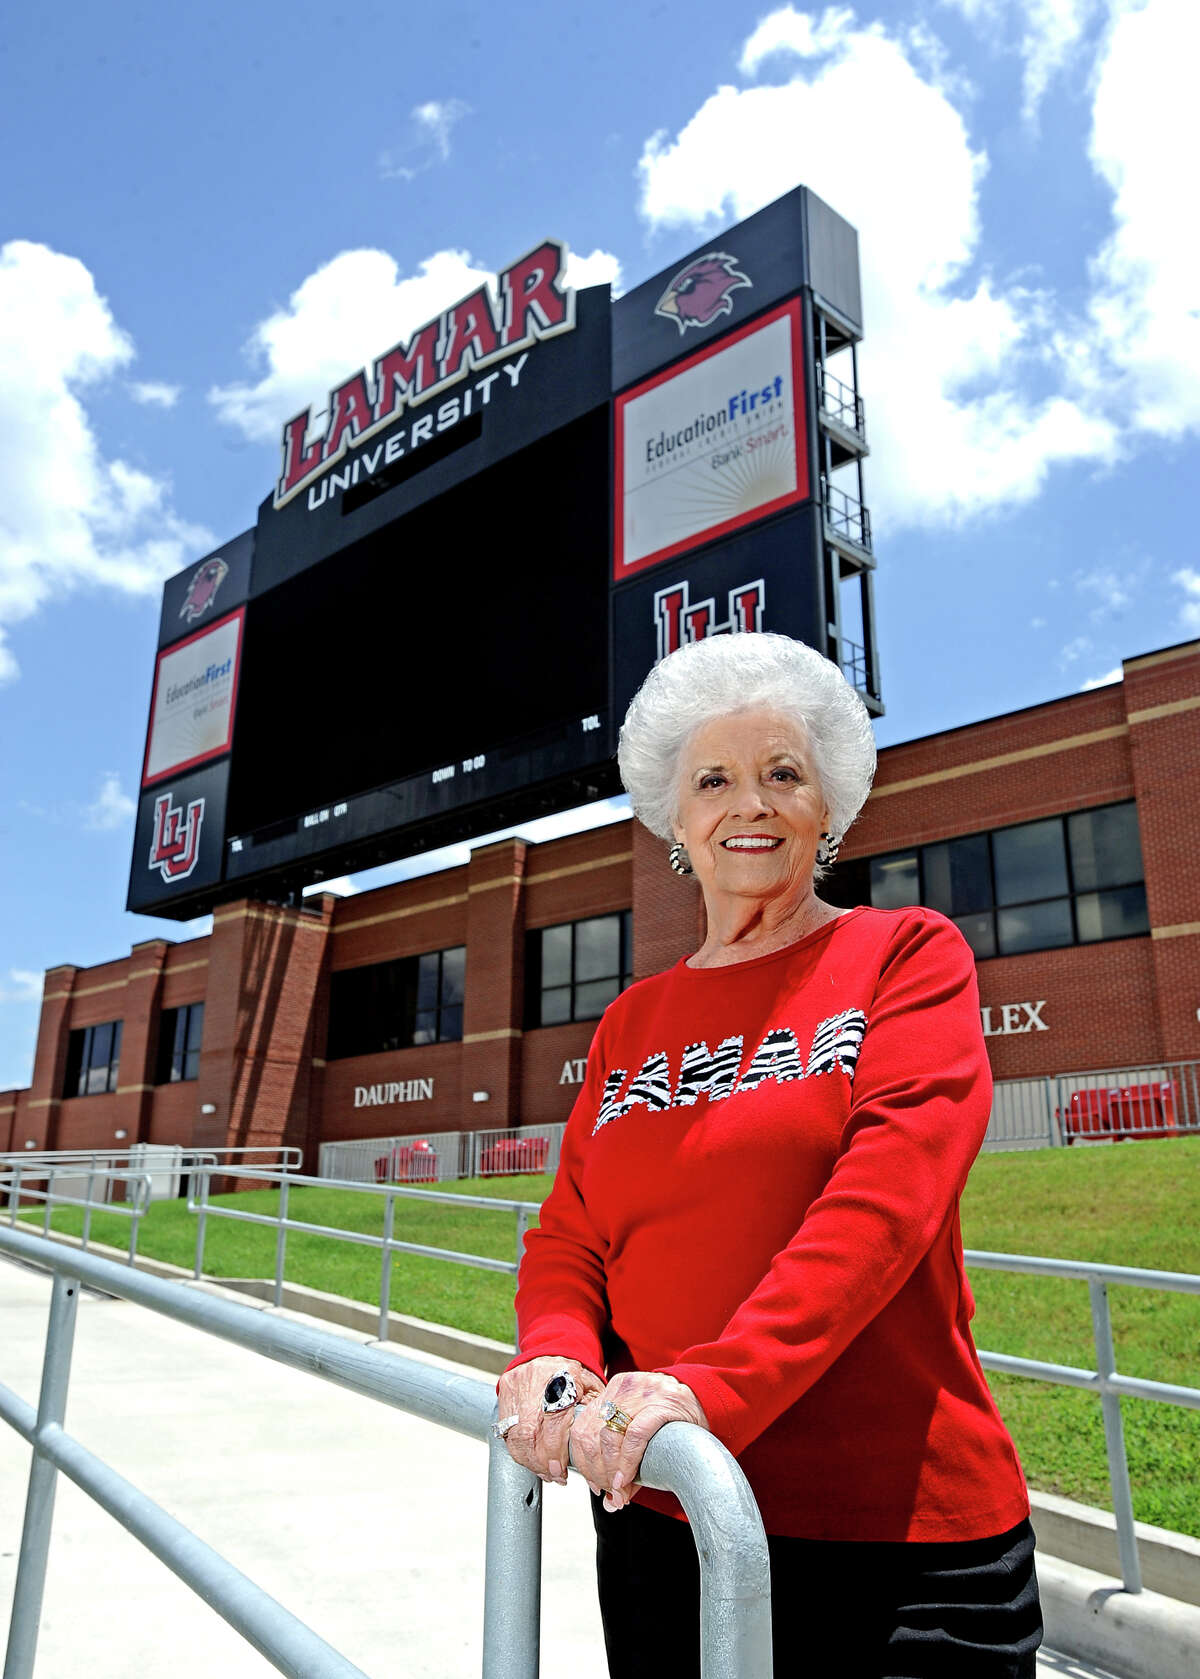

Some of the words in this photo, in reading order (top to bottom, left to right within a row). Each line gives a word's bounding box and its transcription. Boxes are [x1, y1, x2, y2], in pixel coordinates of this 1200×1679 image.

[273, 237, 577, 510] LAMAR
[307, 353, 529, 511] UNIVERSITY
[149, 792, 205, 883] LU
[353, 1077, 435, 1108] DAUPHIN
[559, 1058, 588, 1085] AT
[980, 1000, 1050, 1037] LEX
[592, 1007, 868, 1136] LAMAR
